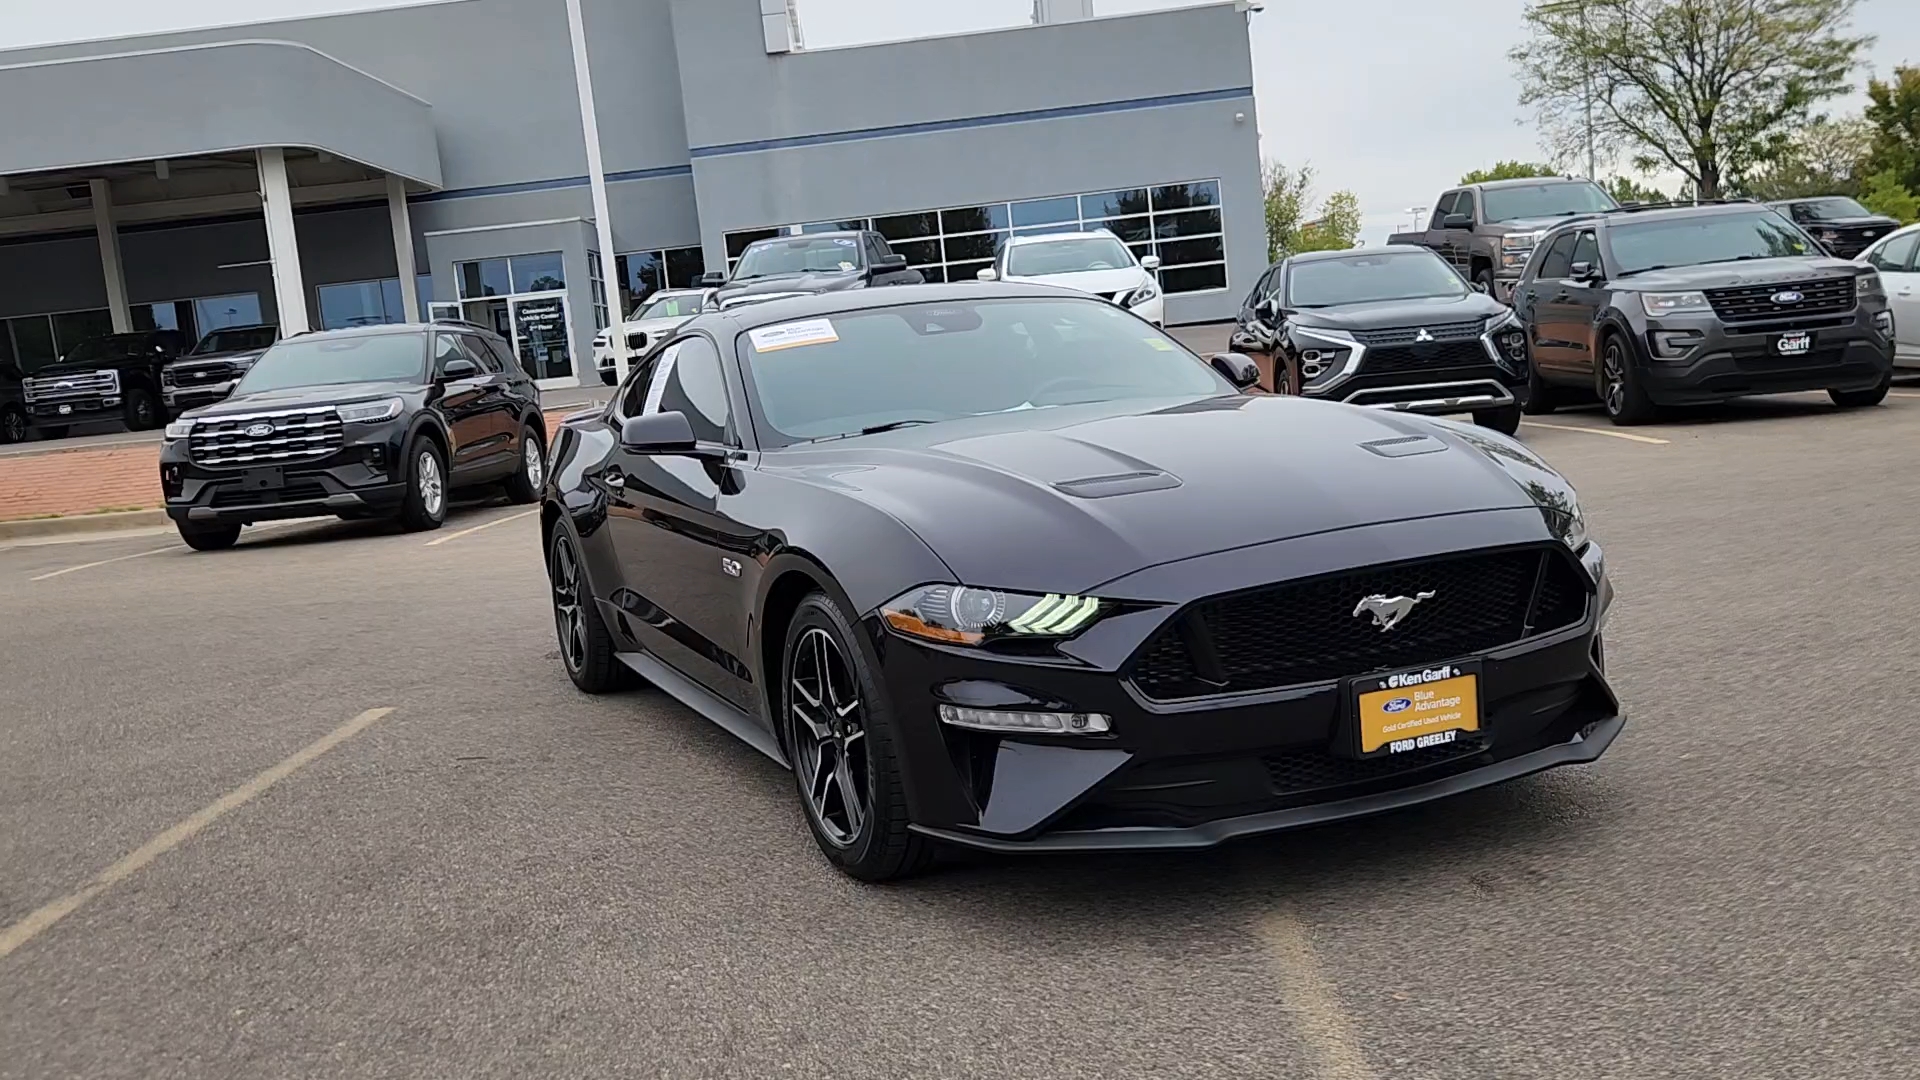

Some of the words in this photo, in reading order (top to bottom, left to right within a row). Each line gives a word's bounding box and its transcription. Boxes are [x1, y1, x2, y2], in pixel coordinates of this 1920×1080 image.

[1777, 336, 1811, 351] Garff
[247, 425, 272, 436] Ford
[1399, 673, 1421, 687] Ken
[1422, 666, 1451, 682] Garff
[1414, 690, 1434, 701] Blue
[1414, 695, 1461, 712] Advantage
[1385, 698, 1409, 713] Ford
[1382, 724, 1397, 733] Gold
[1397, 718, 1422, 730] Certified
[1423, 715, 1440, 724] Used
[1440, 712, 1462, 721] Vehicle
[1390, 740, 1415, 754] FORD
[1417, 730, 1457, 749] GREELEY
